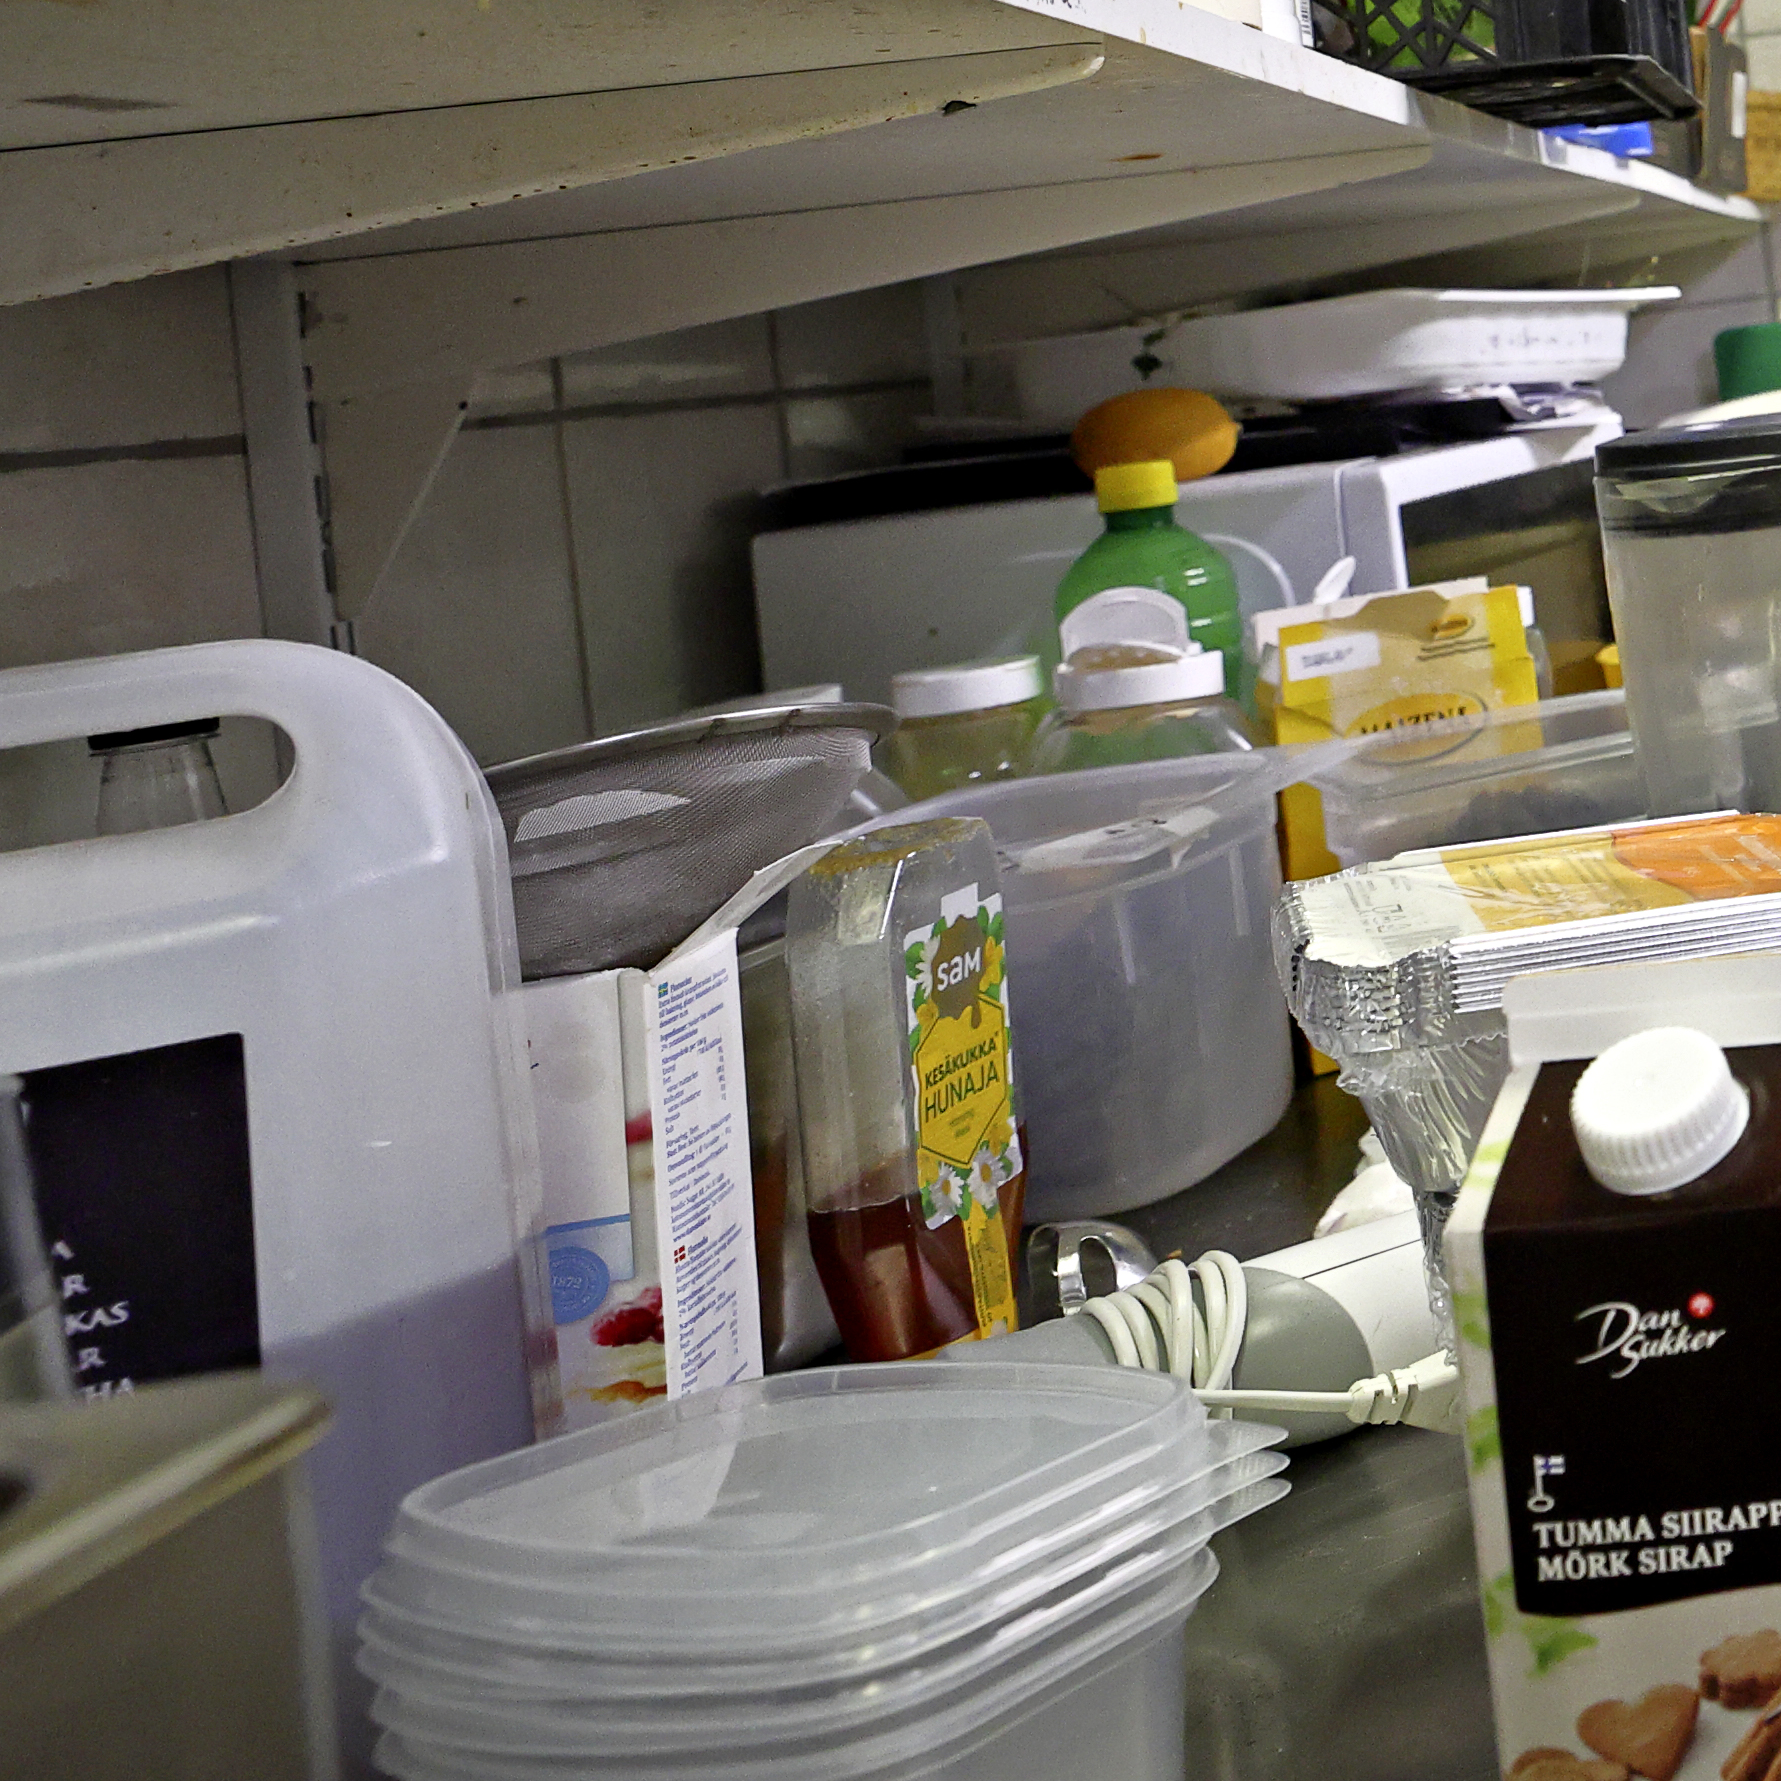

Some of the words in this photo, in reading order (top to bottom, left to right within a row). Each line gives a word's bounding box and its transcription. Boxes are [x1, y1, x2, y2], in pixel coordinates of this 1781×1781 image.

[924, 1060, 1001, 1124] HUNAJA
[1610, 1327, 1727, 1380] Sukker
[1531, 1514, 1656, 1550] TUMMA
[1537, 1549, 1633, 1583] MÖRK
[1637, 1539, 1734, 1575] SIRAP
